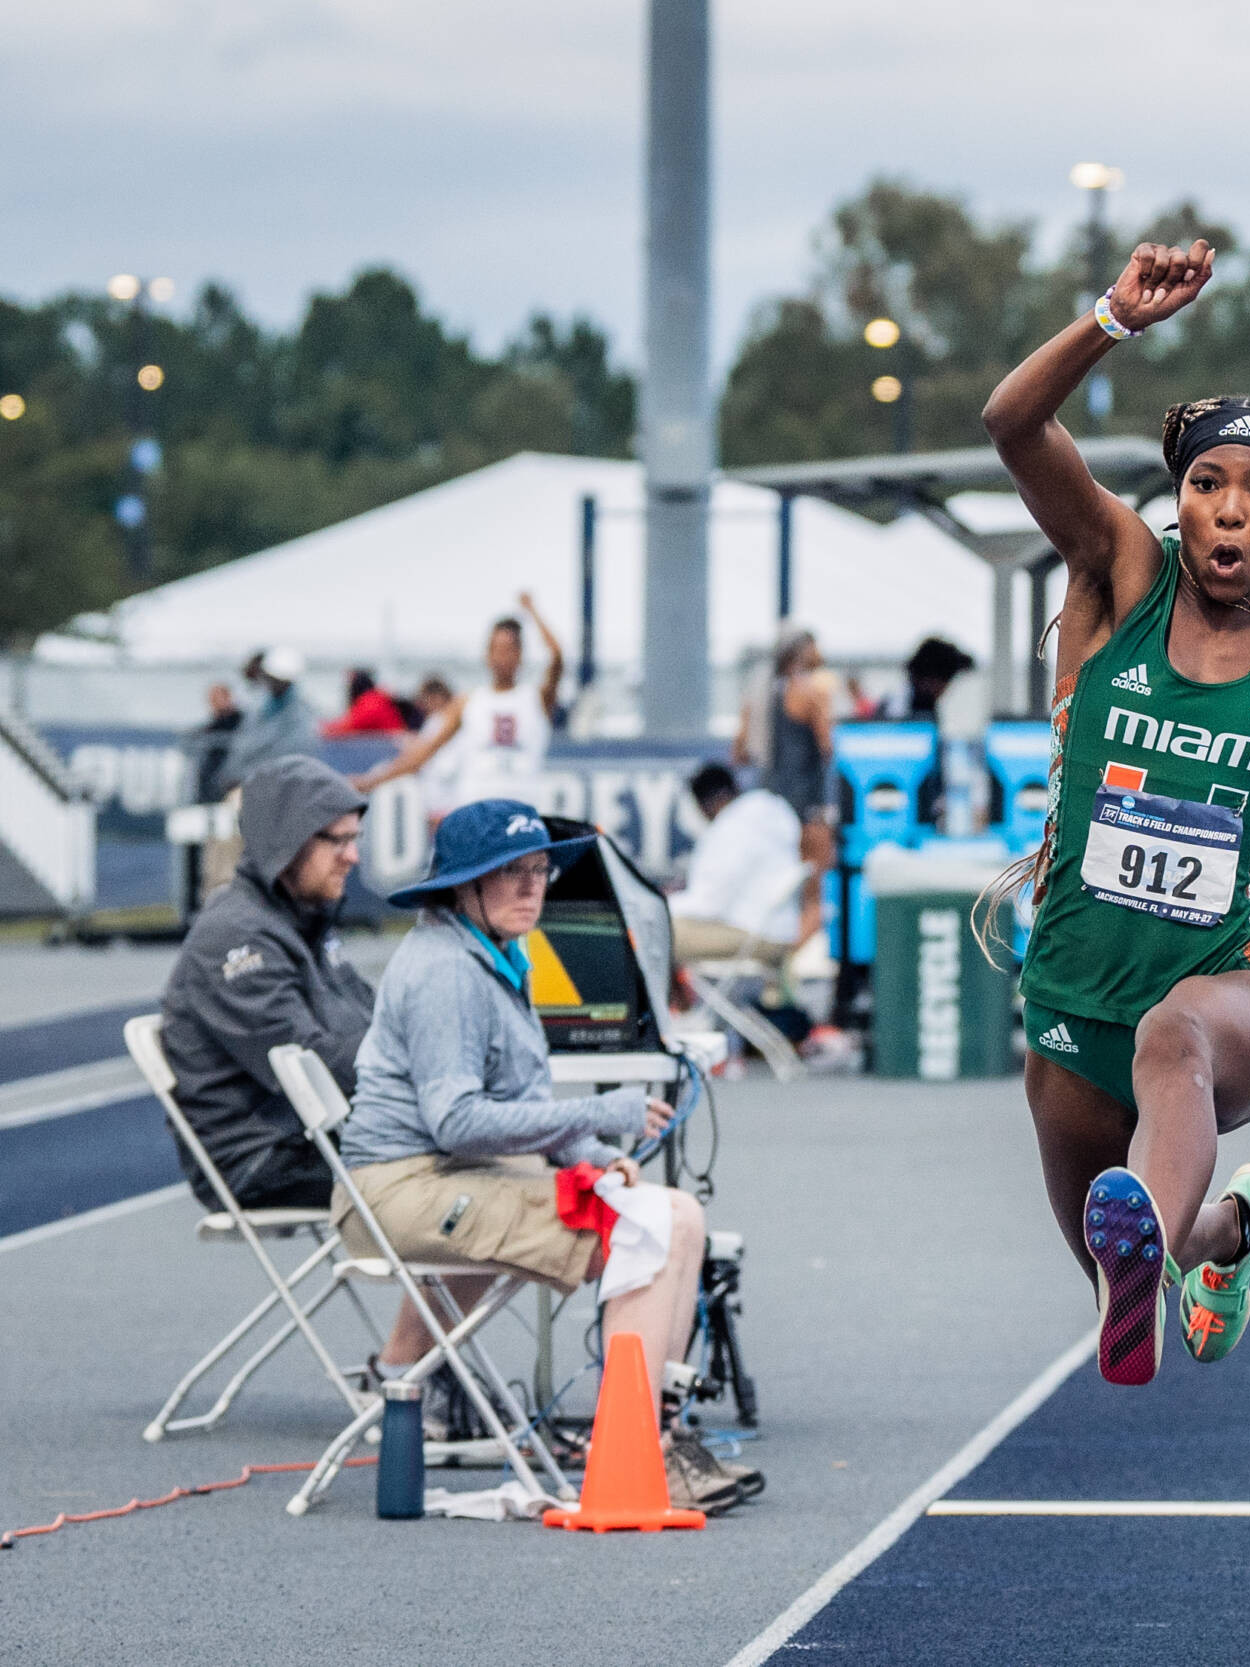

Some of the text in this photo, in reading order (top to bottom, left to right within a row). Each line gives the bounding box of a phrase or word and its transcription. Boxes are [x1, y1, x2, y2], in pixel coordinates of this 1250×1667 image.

[1111, 677, 1152, 696] adidas
[1117, 811, 1143, 826] TRACK
[1149, 820, 1171, 832] FIELD
[1172, 824, 1237, 843] CHAMPIONSHIPS
[1119, 844, 1203, 900] 912
[1094, 891, 1148, 911] JACKSONVILLE,
[1149, 904, 1159, 913] FL
[1170, 908, 1188, 921] MAY
[1038, 1036, 1079, 1053] adidas
